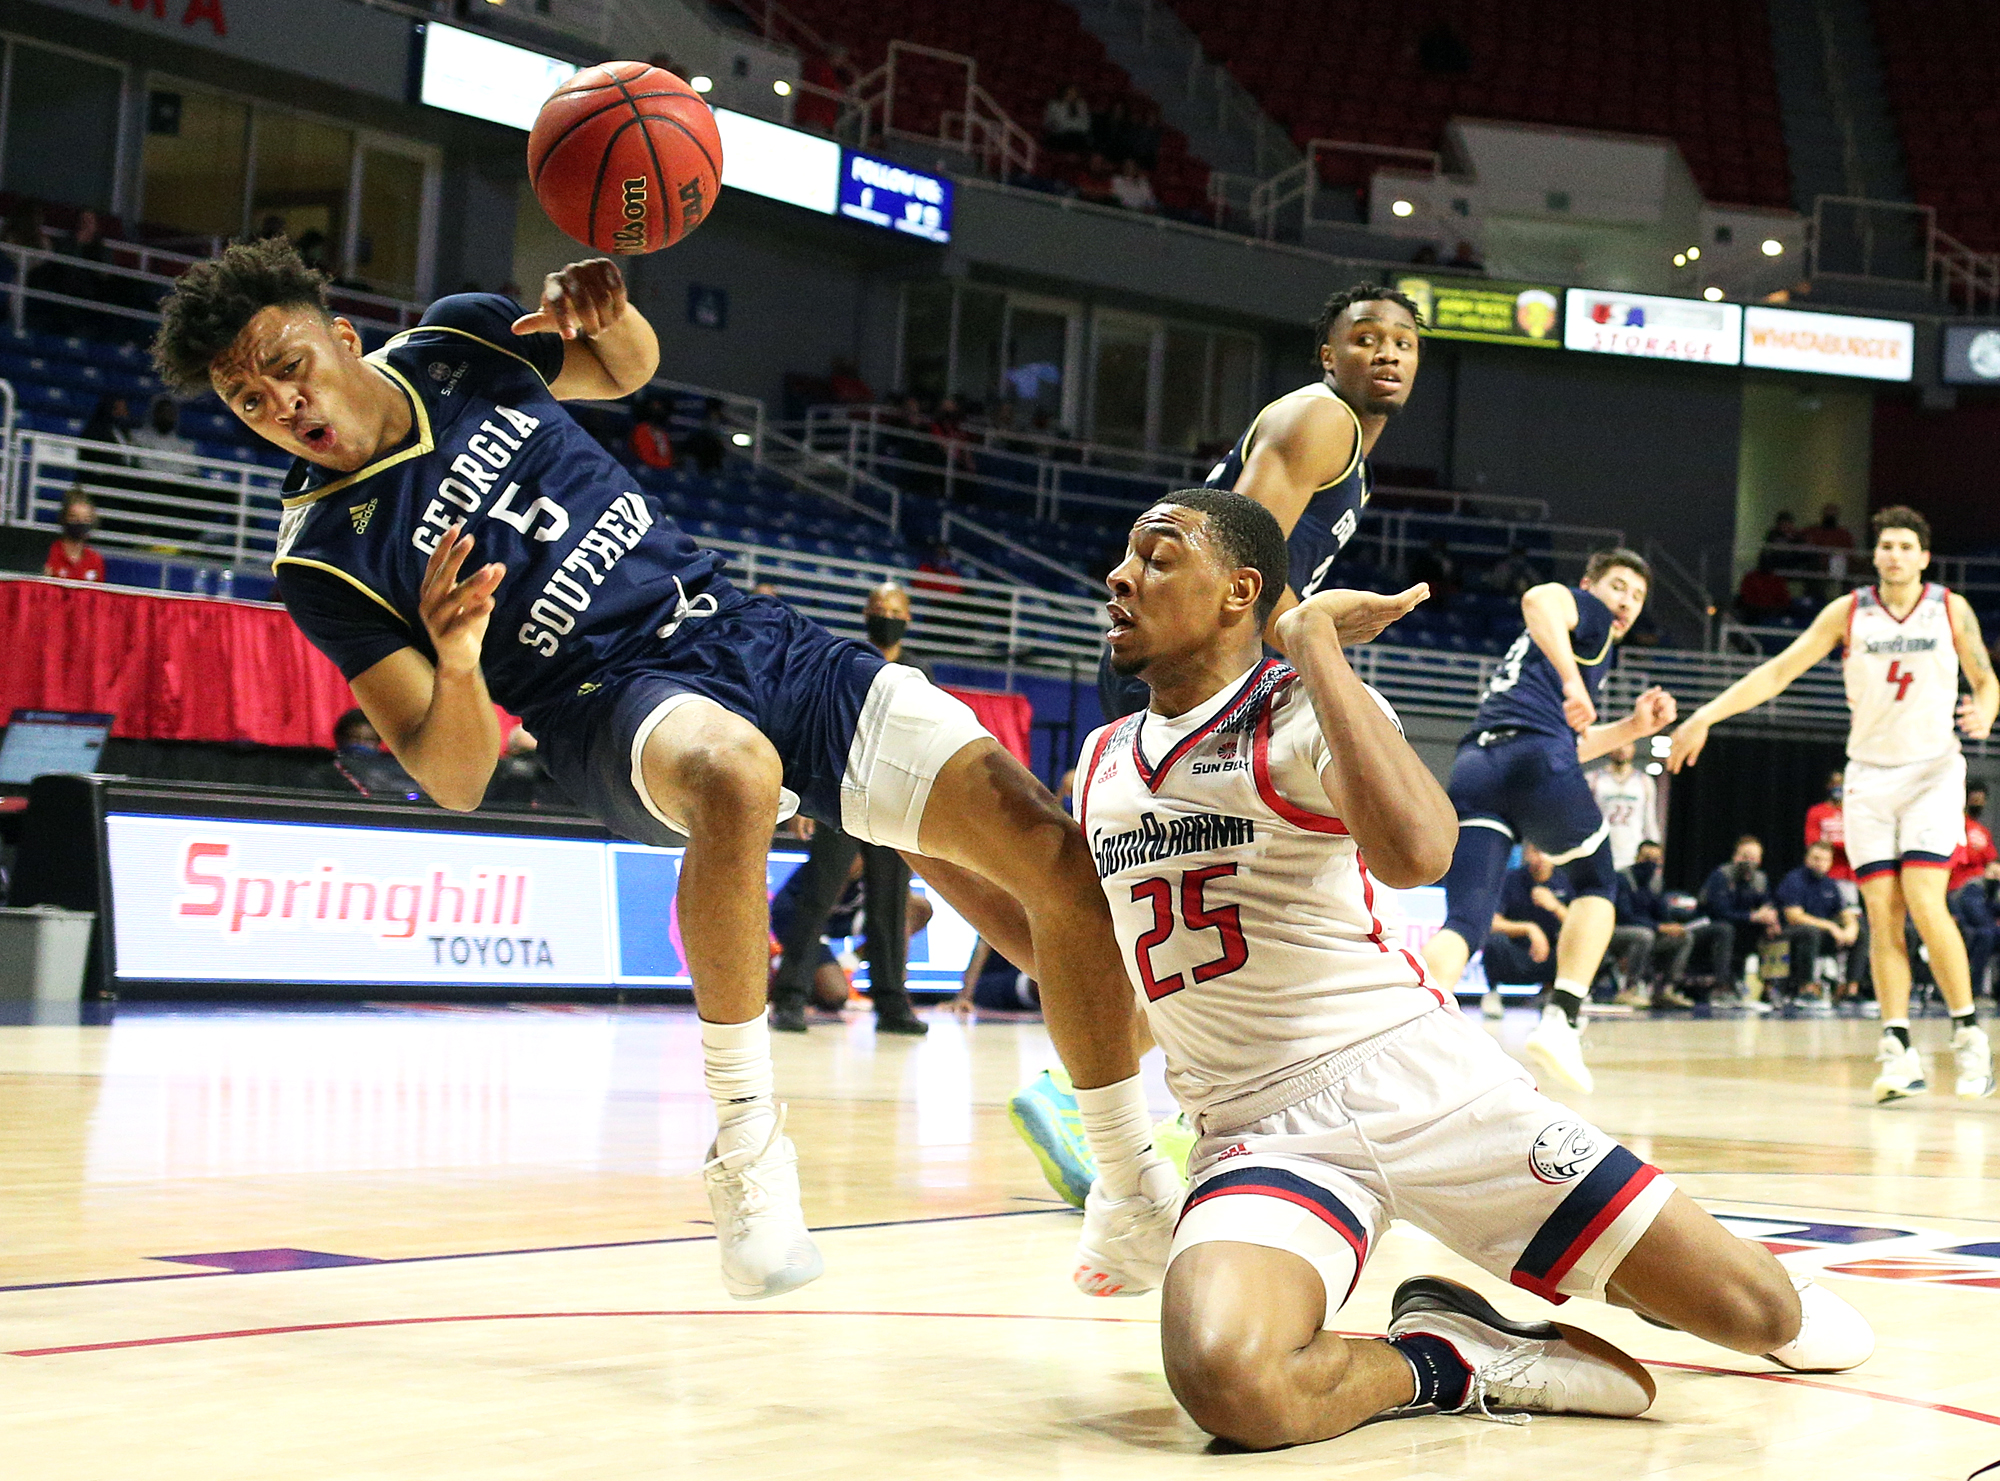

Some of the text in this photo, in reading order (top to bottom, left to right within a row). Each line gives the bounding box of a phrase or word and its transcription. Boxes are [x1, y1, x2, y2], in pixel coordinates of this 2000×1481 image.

[1590, 332, 1713, 361] STORAGE
[1750, 327, 1901, 359] WHATABURGER
[411, 405, 540, 556] GEORGIA
[355, 497, 379, 535] adidas
[487, 481, 570, 542] 5
[1887, 661, 1914, 701] 4
[1191, 761, 1250, 775] SUN BELT
[179, 842, 526, 938] Springhill
[428, 936, 554, 966] TOYOTA
[1130, 861, 1249, 1003] 25
